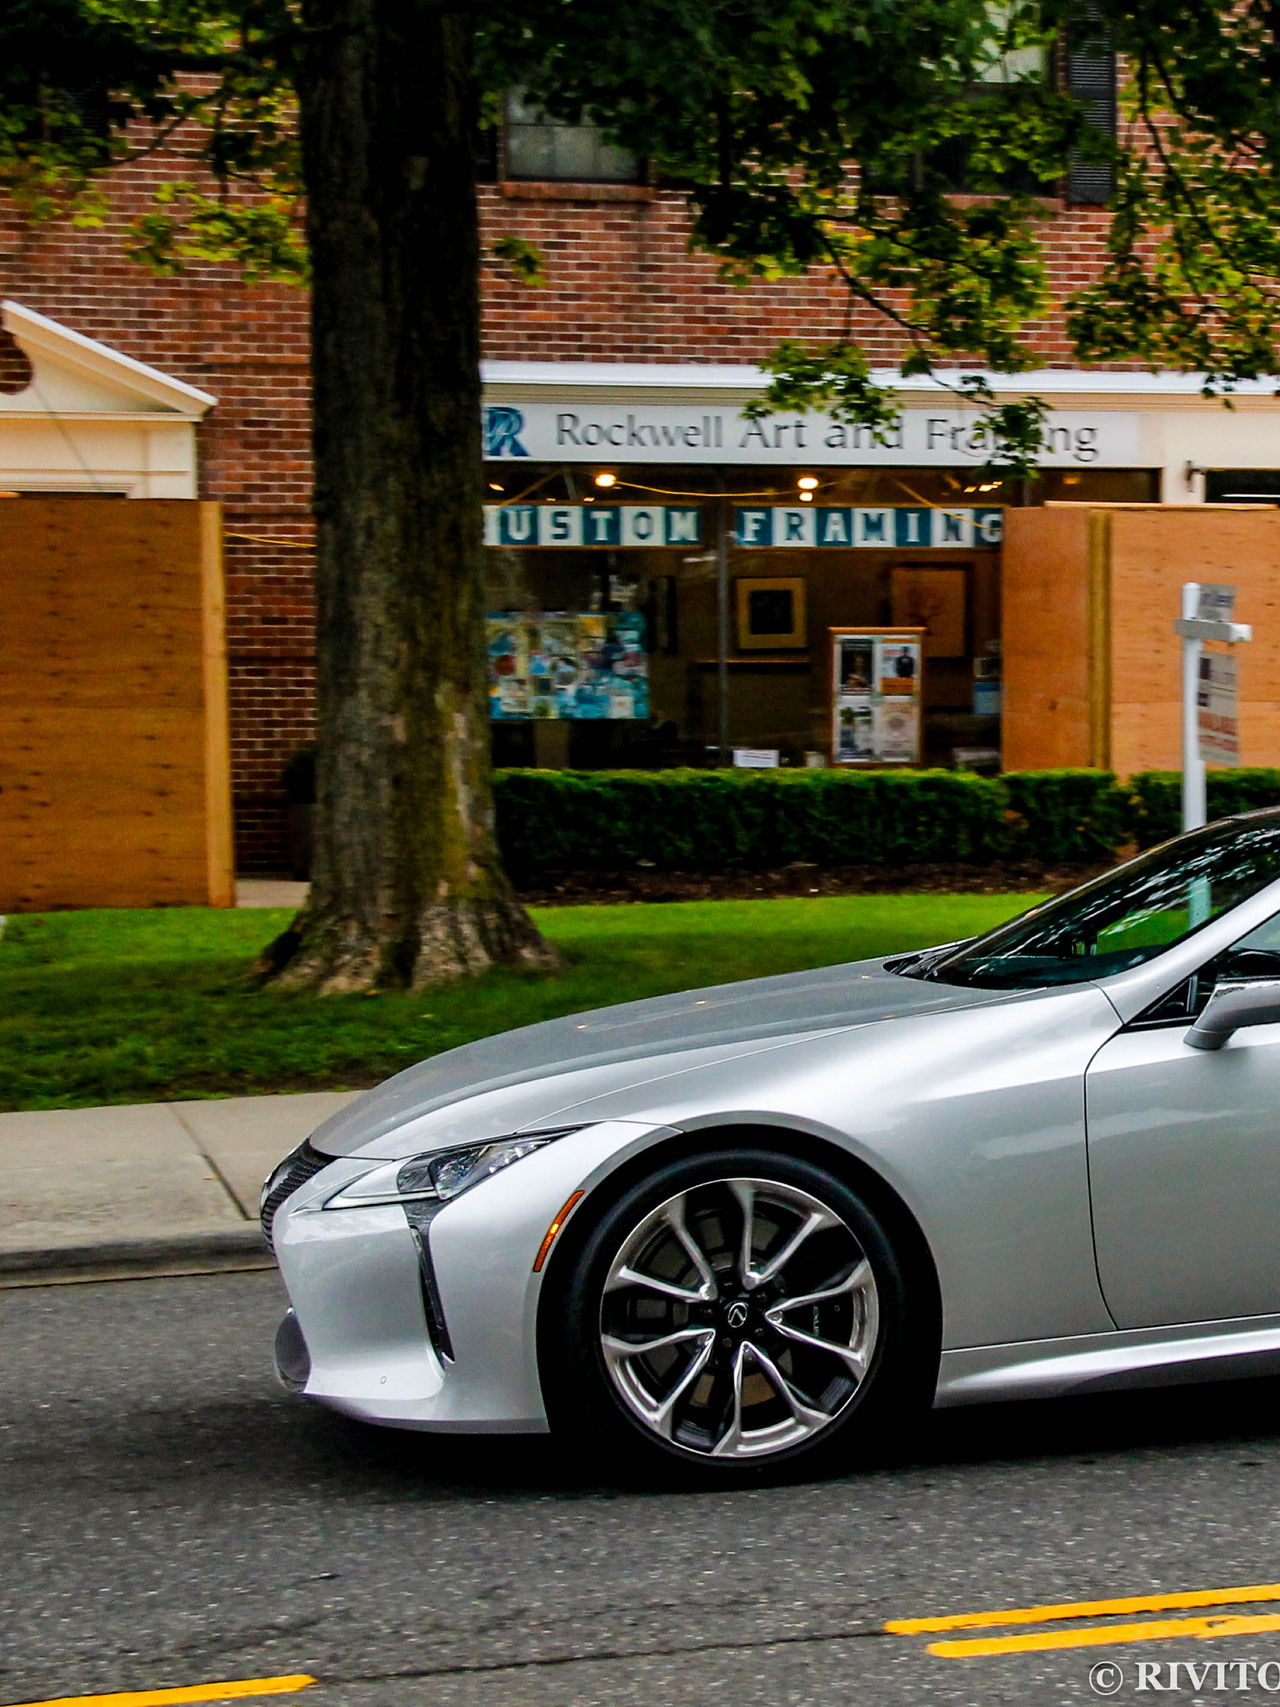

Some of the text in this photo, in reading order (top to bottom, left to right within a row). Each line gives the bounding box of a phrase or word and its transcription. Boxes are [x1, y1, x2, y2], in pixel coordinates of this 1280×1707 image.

[556, 412, 722, 448] Rockwell
[738, 416, 807, 449] Art
[824, 415, 903, 449] and
[926, 418, 1099, 462] Frang
[507, 510, 1003, 543] USTOM FRAMING
